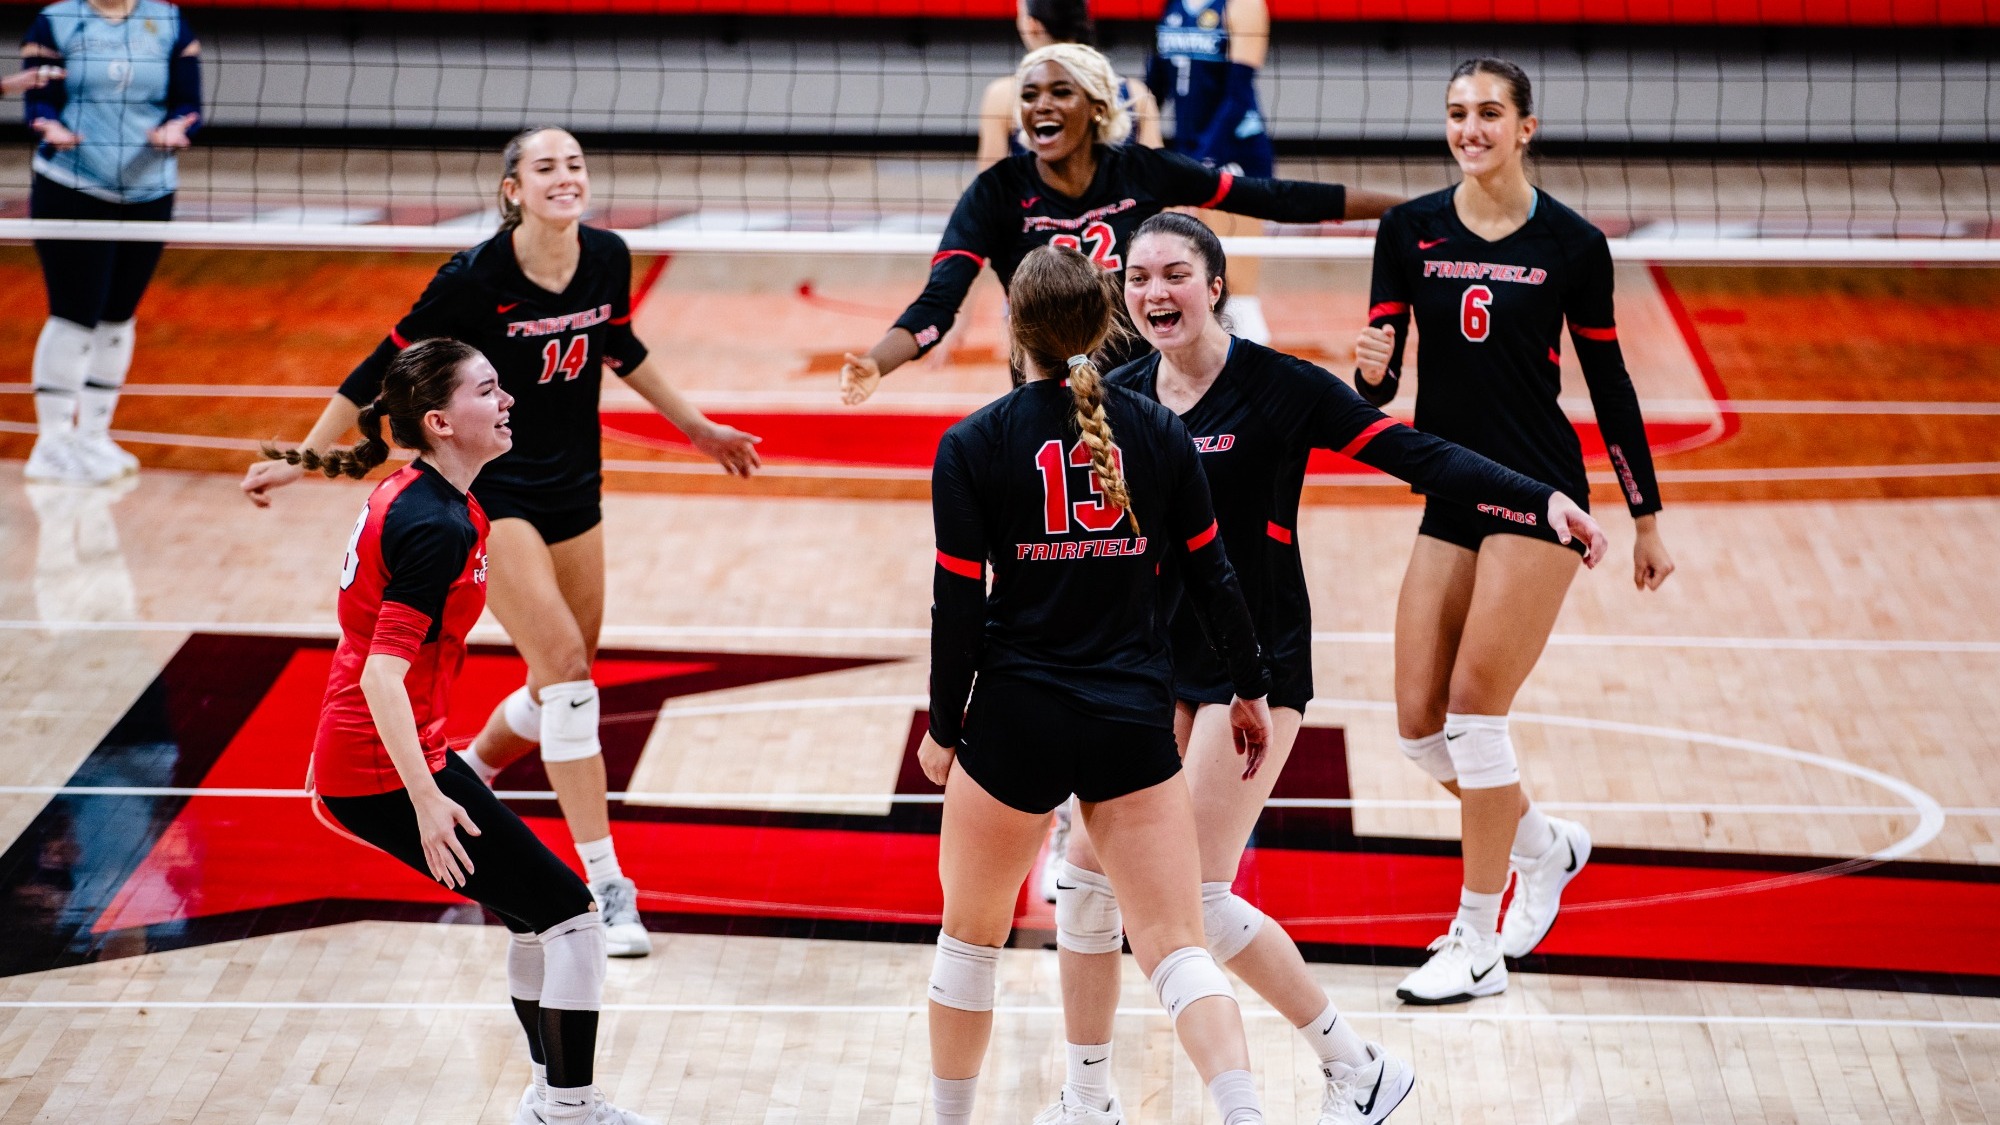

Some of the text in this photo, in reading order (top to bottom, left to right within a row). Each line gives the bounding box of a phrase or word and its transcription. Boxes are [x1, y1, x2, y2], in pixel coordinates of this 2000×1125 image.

[1424, 260, 1548, 285] FAIRFIELD
[507, 303, 612, 337] FAIRFIELD
[1460, 284, 1494, 343] 6
[537, 333, 589, 384] 14
[1035, 440, 1125, 534] 13
[1477, 503, 1537, 526] STAGS
[1016, 537, 1148, 560] FAIRFIELD
